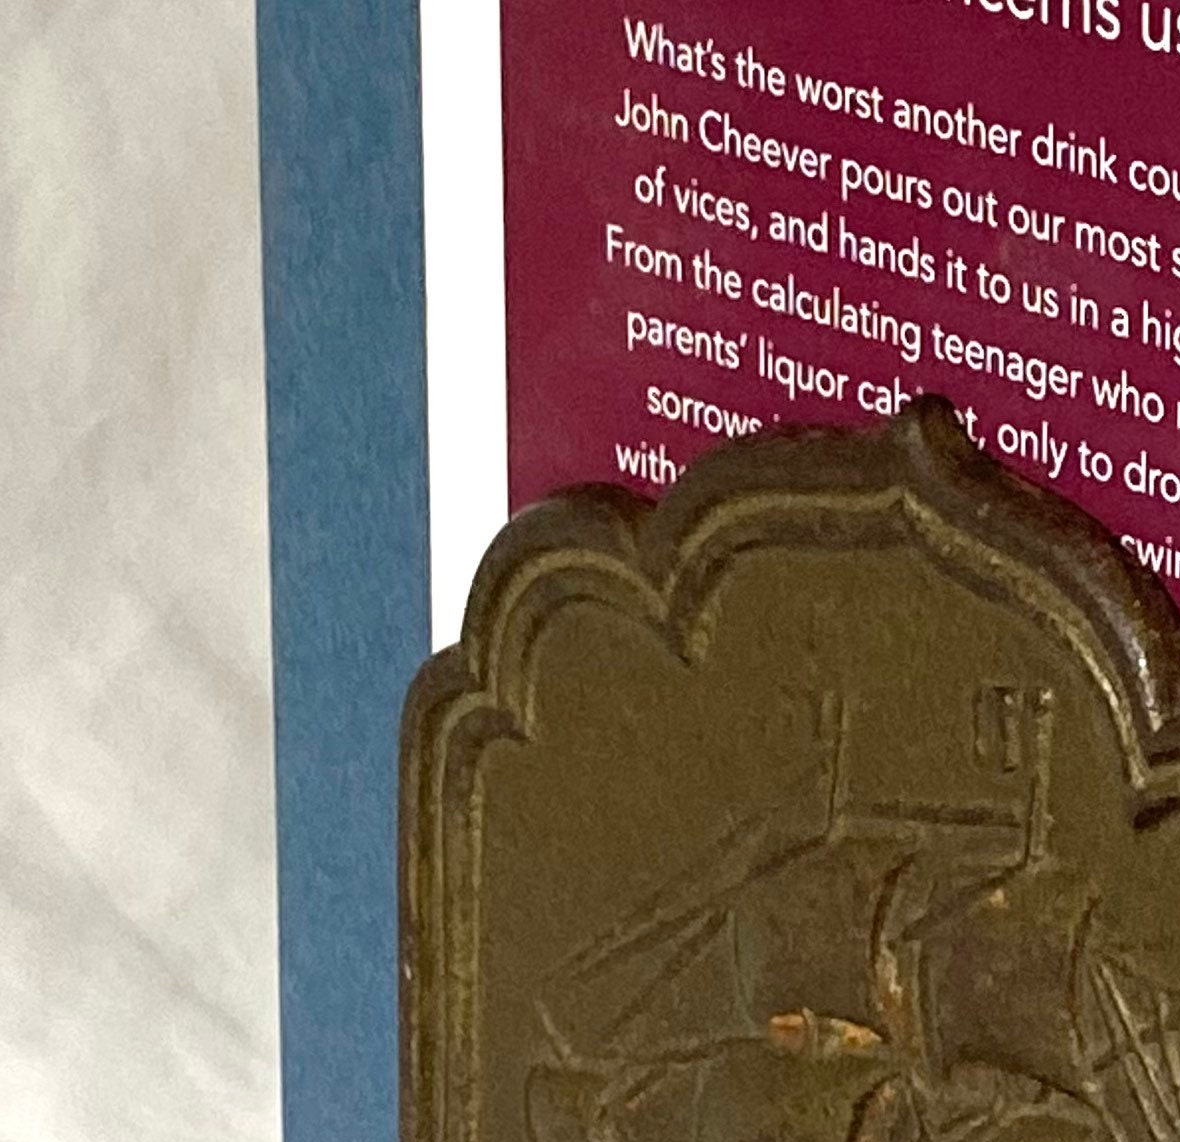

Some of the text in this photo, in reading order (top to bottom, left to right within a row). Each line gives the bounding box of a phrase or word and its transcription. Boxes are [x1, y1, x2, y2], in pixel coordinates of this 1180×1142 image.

[615, 88, 689, 143] John
[699, 109, 831, 180] Cheever
[842, 159, 933, 209] pours
[943, 187, 999, 228] out
[1009, 205, 1066, 244] our
[1076, 222, 1162, 273] most
[624, 16, 725, 81] What's
[735, 47, 786, 97] the
[796, 74, 883, 124] worst
[894, 98, 1022, 157] another
[1032, 122, 1117, 184] drink
[606, 224, 683, 283] From
[693, 248, 742, 299] the
[752, 273, 921, 363] calculating
[932, 323, 1083, 400] teenager
[1092, 369, 1164, 423] who
[635, 165, 667, 206] of
[674, 178, 758, 241] vices,
[769, 211, 829, 253] and
[840, 215, 936, 283] hands
[946, 248, 968, 293] it
[977, 263, 1010, 304] to
[1023, 282, 1060, 318] us
[1071, 283, 1099, 330] in
[1111, 306, 1130, 339] a
[760, 336, 849, 401] liquor
[998, 423, 1068, 479] only
[1078, 441, 1113, 482] to
